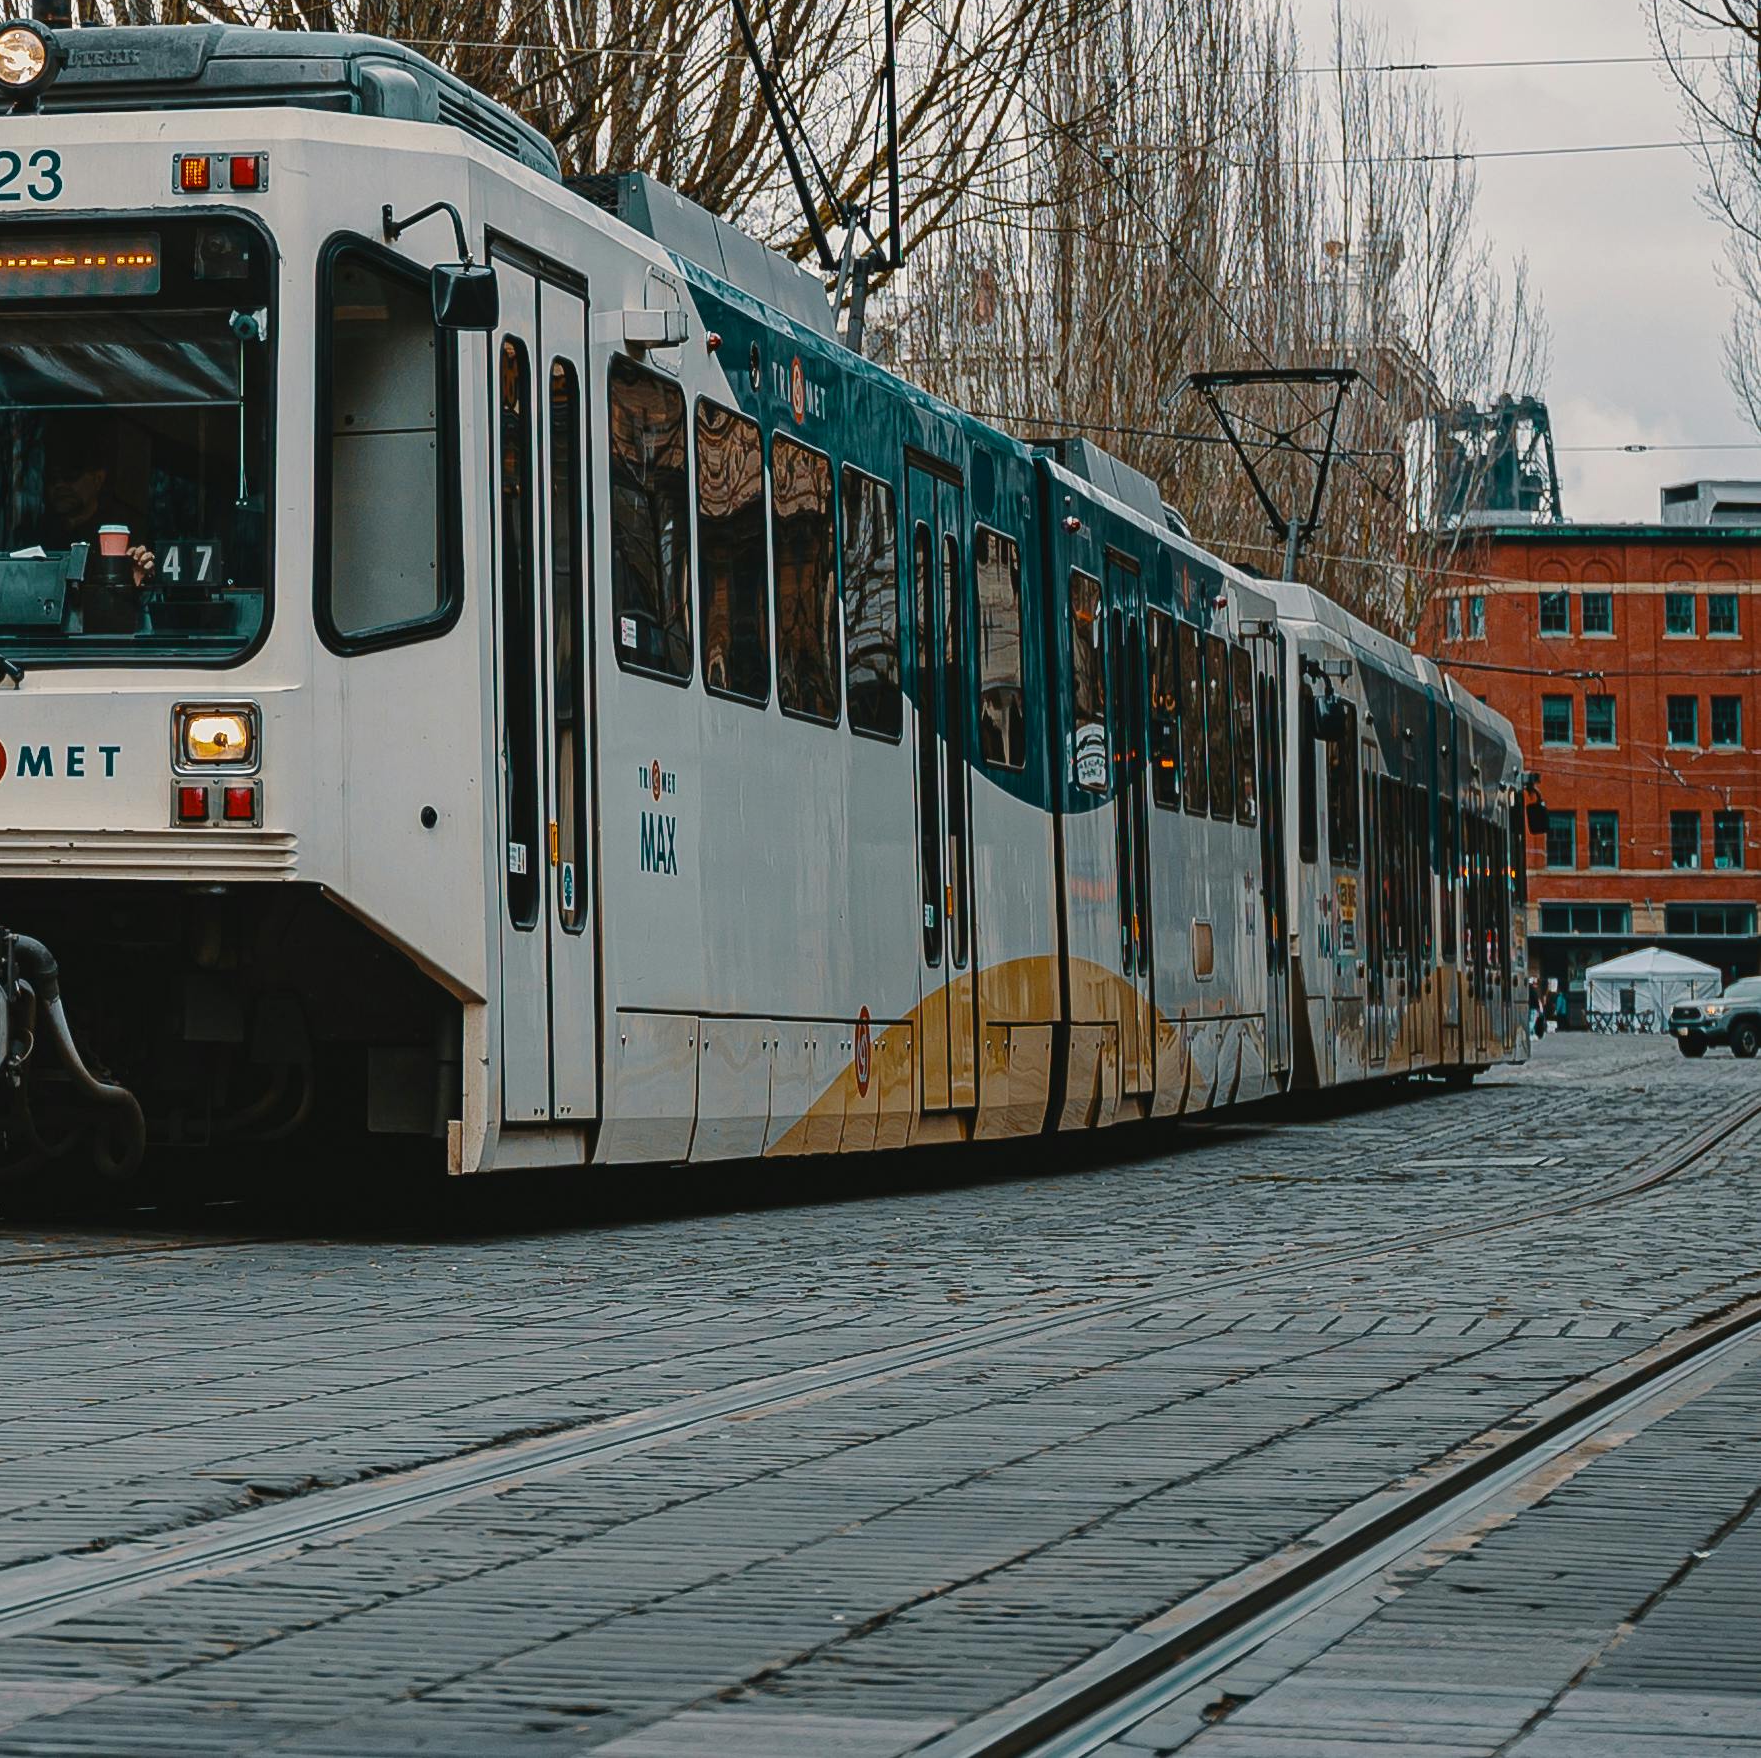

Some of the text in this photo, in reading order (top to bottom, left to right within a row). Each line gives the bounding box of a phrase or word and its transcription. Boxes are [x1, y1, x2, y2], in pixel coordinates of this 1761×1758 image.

[162, 545, 213, 581] 47
[15, 745, 121, 777] MET
[640, 810, 678, 876] MAX
